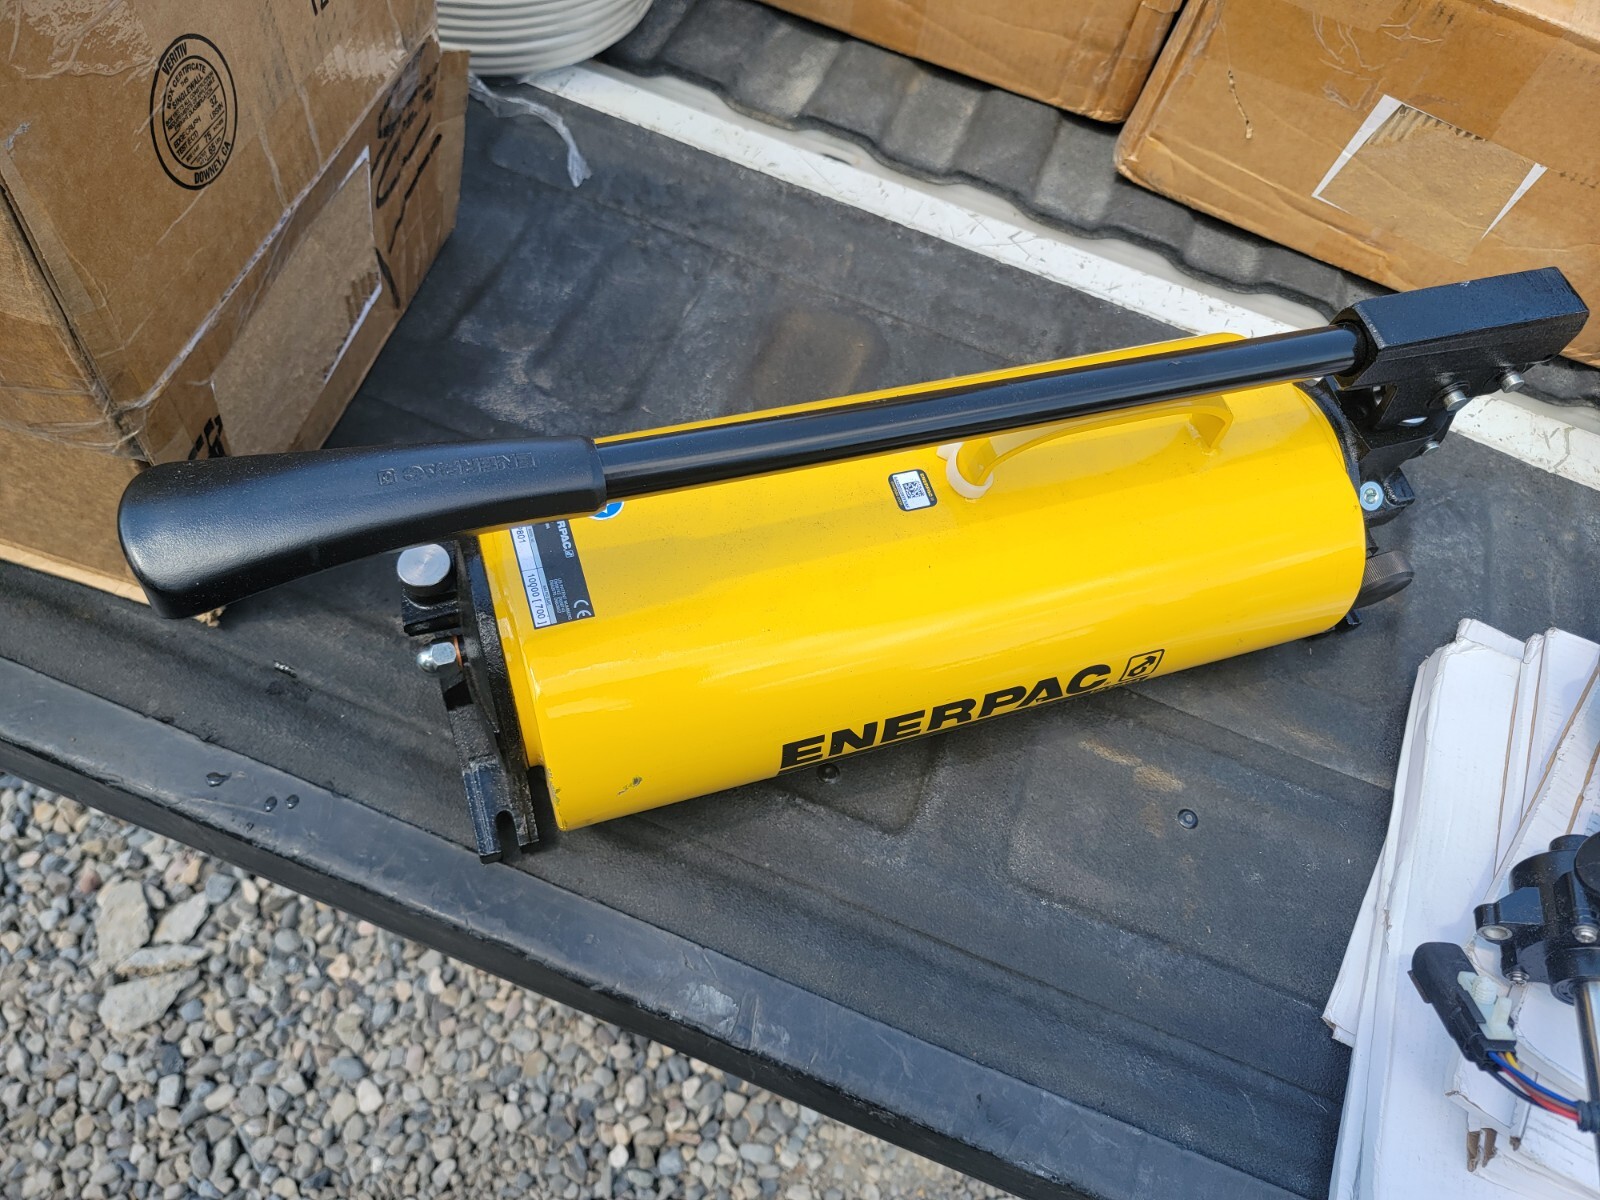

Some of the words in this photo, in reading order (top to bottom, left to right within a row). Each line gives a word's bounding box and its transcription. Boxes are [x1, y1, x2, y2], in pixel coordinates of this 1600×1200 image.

[162, 42, 187, 76] VERITIV
[172, 62, 206, 88] CERTIFICATE
[172, 74, 204, 109] SINGLEWALL
[174, 132, 187, 149] EDGE
[177, 142, 187, 156] TEST
[194, 156, 225, 184] DOWNEY,
[221, 141, 231, 156] CA
[780, 664, 1112, 770] ENERPAC
